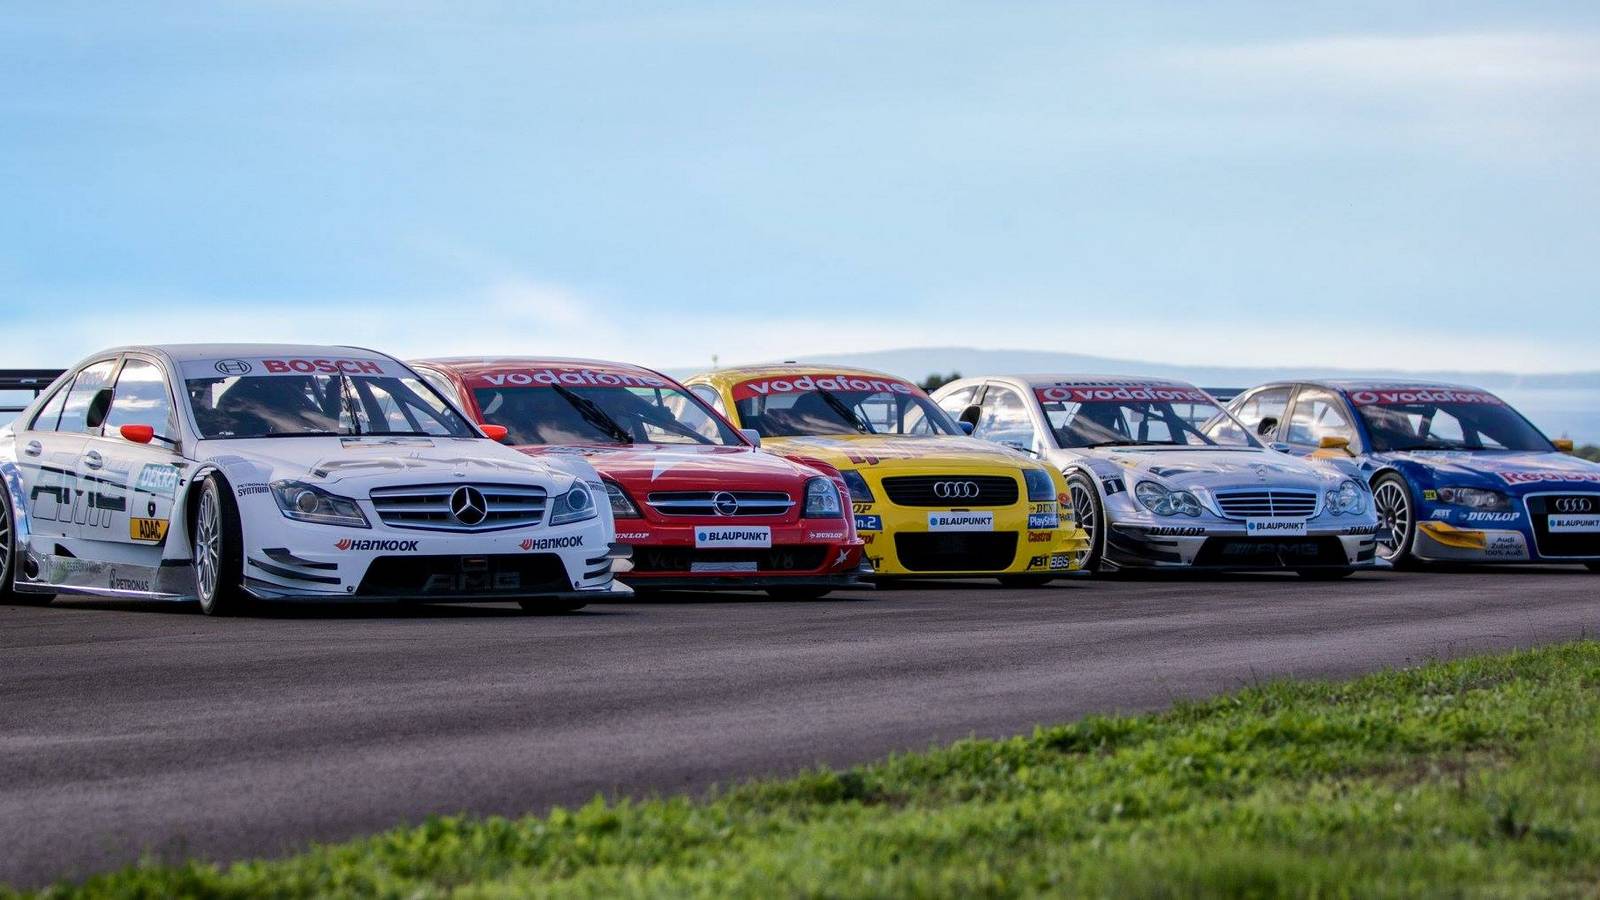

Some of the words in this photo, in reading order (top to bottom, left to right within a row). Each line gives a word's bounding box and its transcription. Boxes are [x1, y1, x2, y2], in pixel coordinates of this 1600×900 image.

[262, 360, 384, 375] BOSCH
[481, 369, 666, 387] vodafone
[747, 375, 912, 395] vodafone
[1075, 387, 1206, 401] vodafone
[1379, 390, 1502, 404] vodafone
[1107, 479, 1119, 493] 1
[1430, 508, 1452, 519] ABT
[1466, 511, 1520, 521] DUNLOP
[939, 517, 992, 526] BLAUPUNKT
[1257, 522, 1304, 530] BLAUPUNKT
[1557, 519, 1600, 527] BLAUPUNKT
[139, 520, 161, 540] ADAC
[708, 531, 769, 542] BLAUPUNKT
[1151, 526, 1206, 536] DUNLOP
[1027, 555, 1049, 570] ABT
[116, 578, 149, 592] PETRONAS
